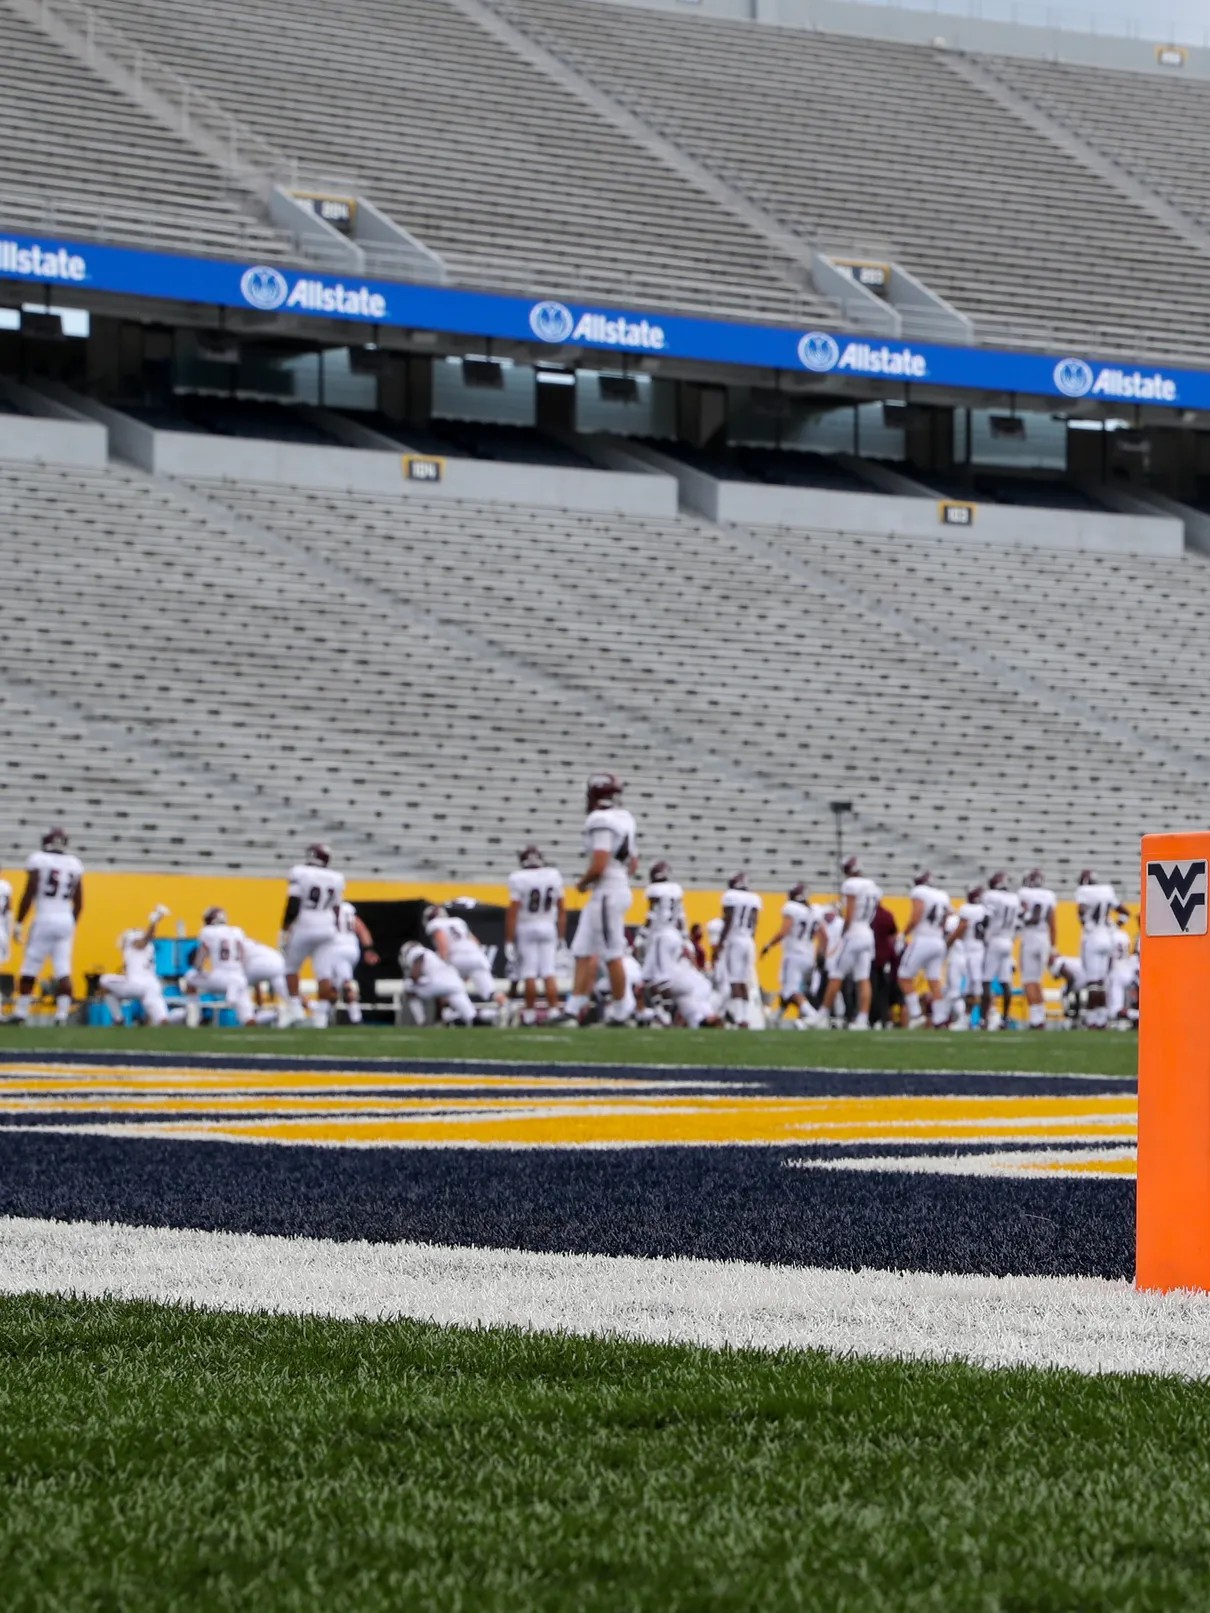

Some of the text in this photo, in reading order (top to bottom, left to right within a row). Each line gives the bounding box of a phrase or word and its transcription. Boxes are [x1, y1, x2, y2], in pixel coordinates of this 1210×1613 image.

[0, 240, 85, 281] llstate
[286, 279, 386, 318] Allstate
[571, 313, 665, 349] Allstate
[837, 342, 926, 377] Allstate
[1091, 368, 1176, 401] Allstate
[43, 868, 74, 899] 53
